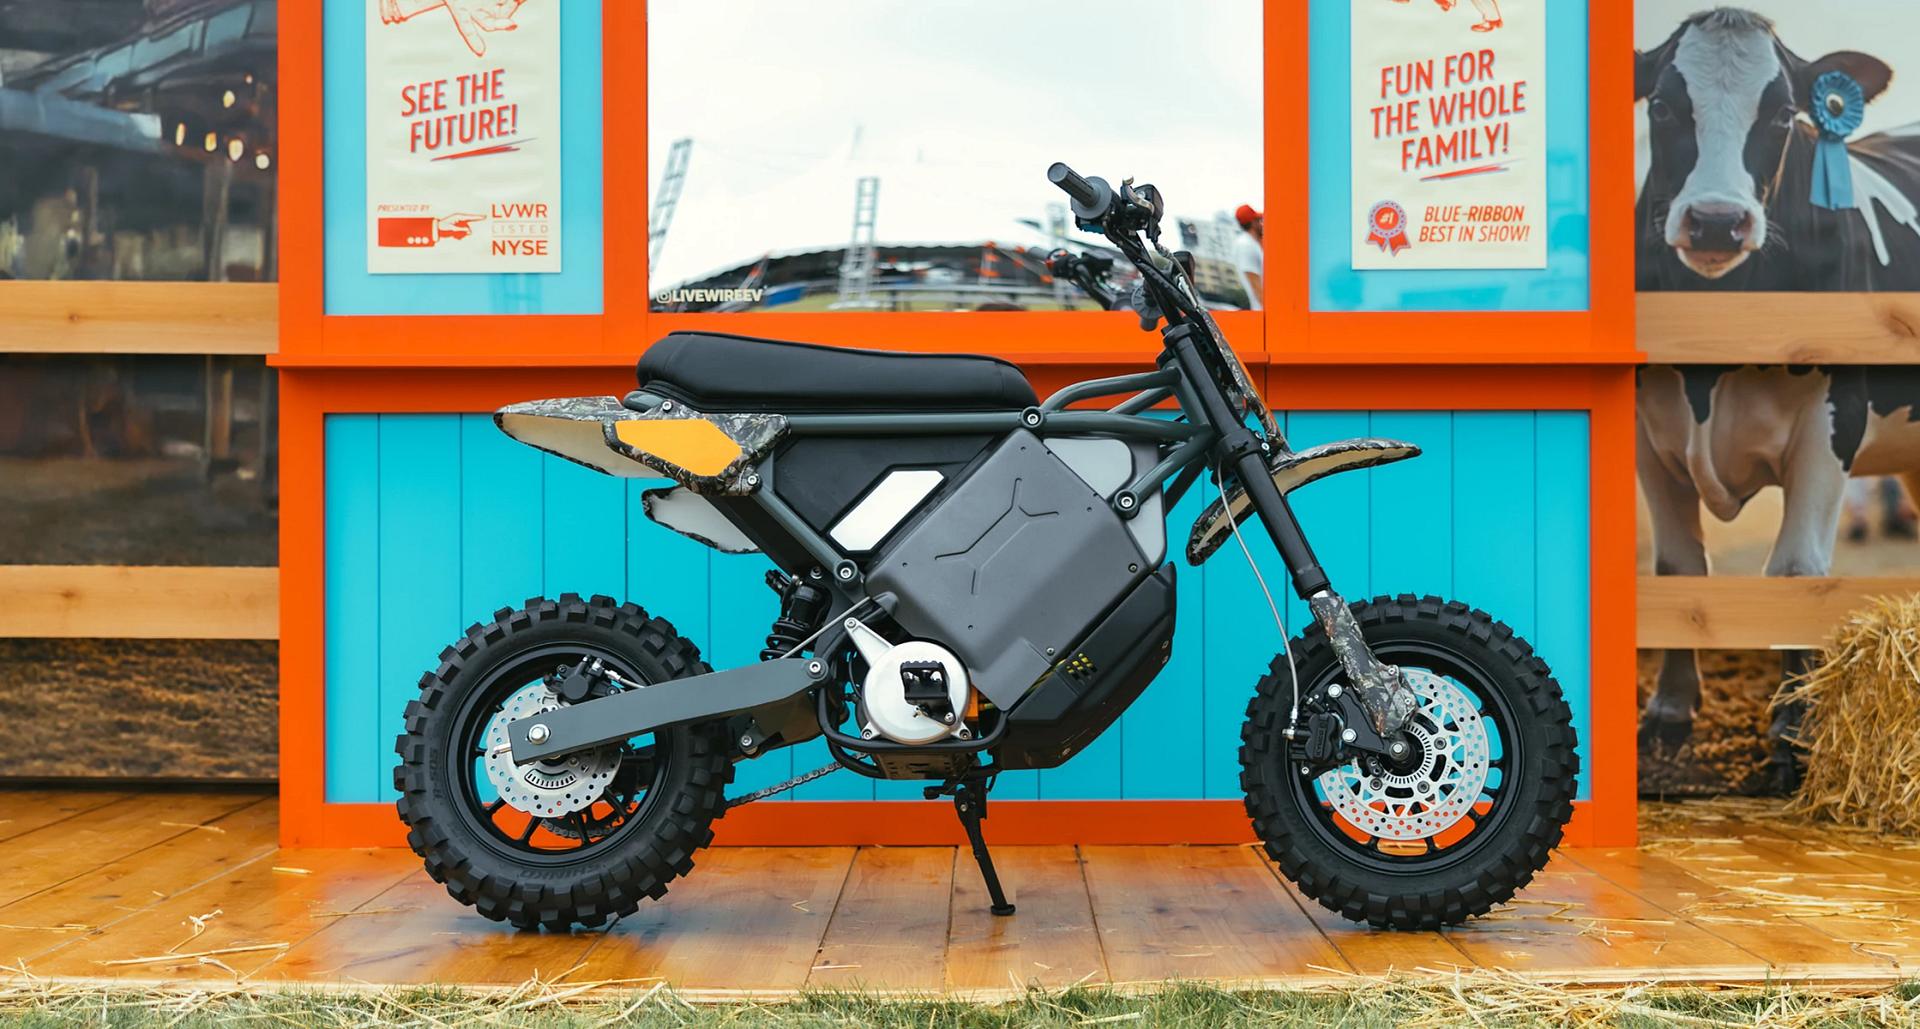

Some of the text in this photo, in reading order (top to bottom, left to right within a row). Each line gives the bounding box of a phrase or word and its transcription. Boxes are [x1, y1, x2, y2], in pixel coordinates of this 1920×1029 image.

[1381, 49, 1495, 99] FUN FOR
[401, 68, 505, 117] SEE THE
[1370, 81, 1526, 138] THE WHOLE
[410, 104, 518, 153] FUTURE!
[1401, 122, 1509, 171] FAMILY!
[492, 203, 548, 218] LVWR
[1424, 205, 1525, 222] BLUE-RIBBON
[491, 224, 548, 234] LISTED
[1419, 225, 1530, 242] BEST IN SHOW!
[492, 239, 548, 256] NYSE
[672, 288, 763, 303] LIVEWIREEV
